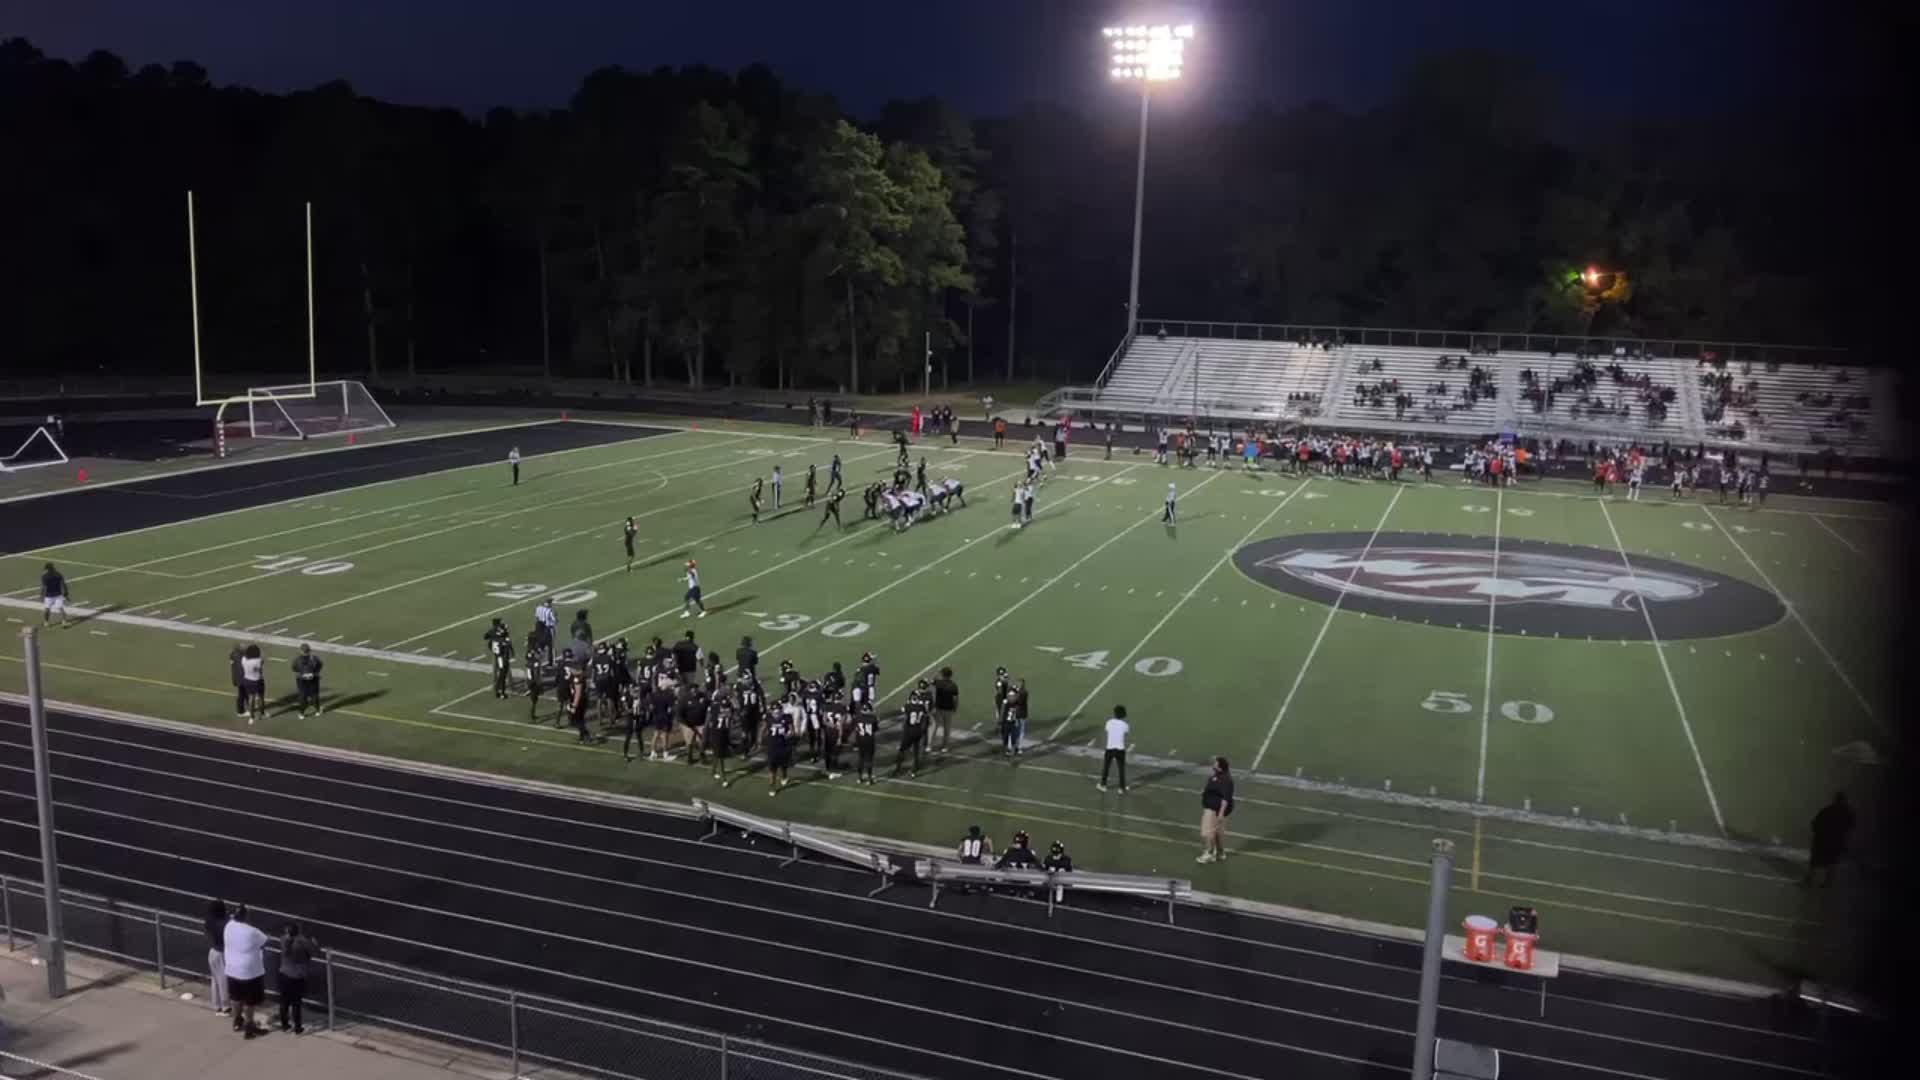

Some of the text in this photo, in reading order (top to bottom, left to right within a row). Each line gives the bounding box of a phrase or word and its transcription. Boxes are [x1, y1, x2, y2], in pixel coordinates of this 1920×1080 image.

[485, 583, 598, 604] 20
[759, 613, 871, 637] 30
[1064, 650, 1184, 677] 40
[1420, 691, 1555, 724] 50
